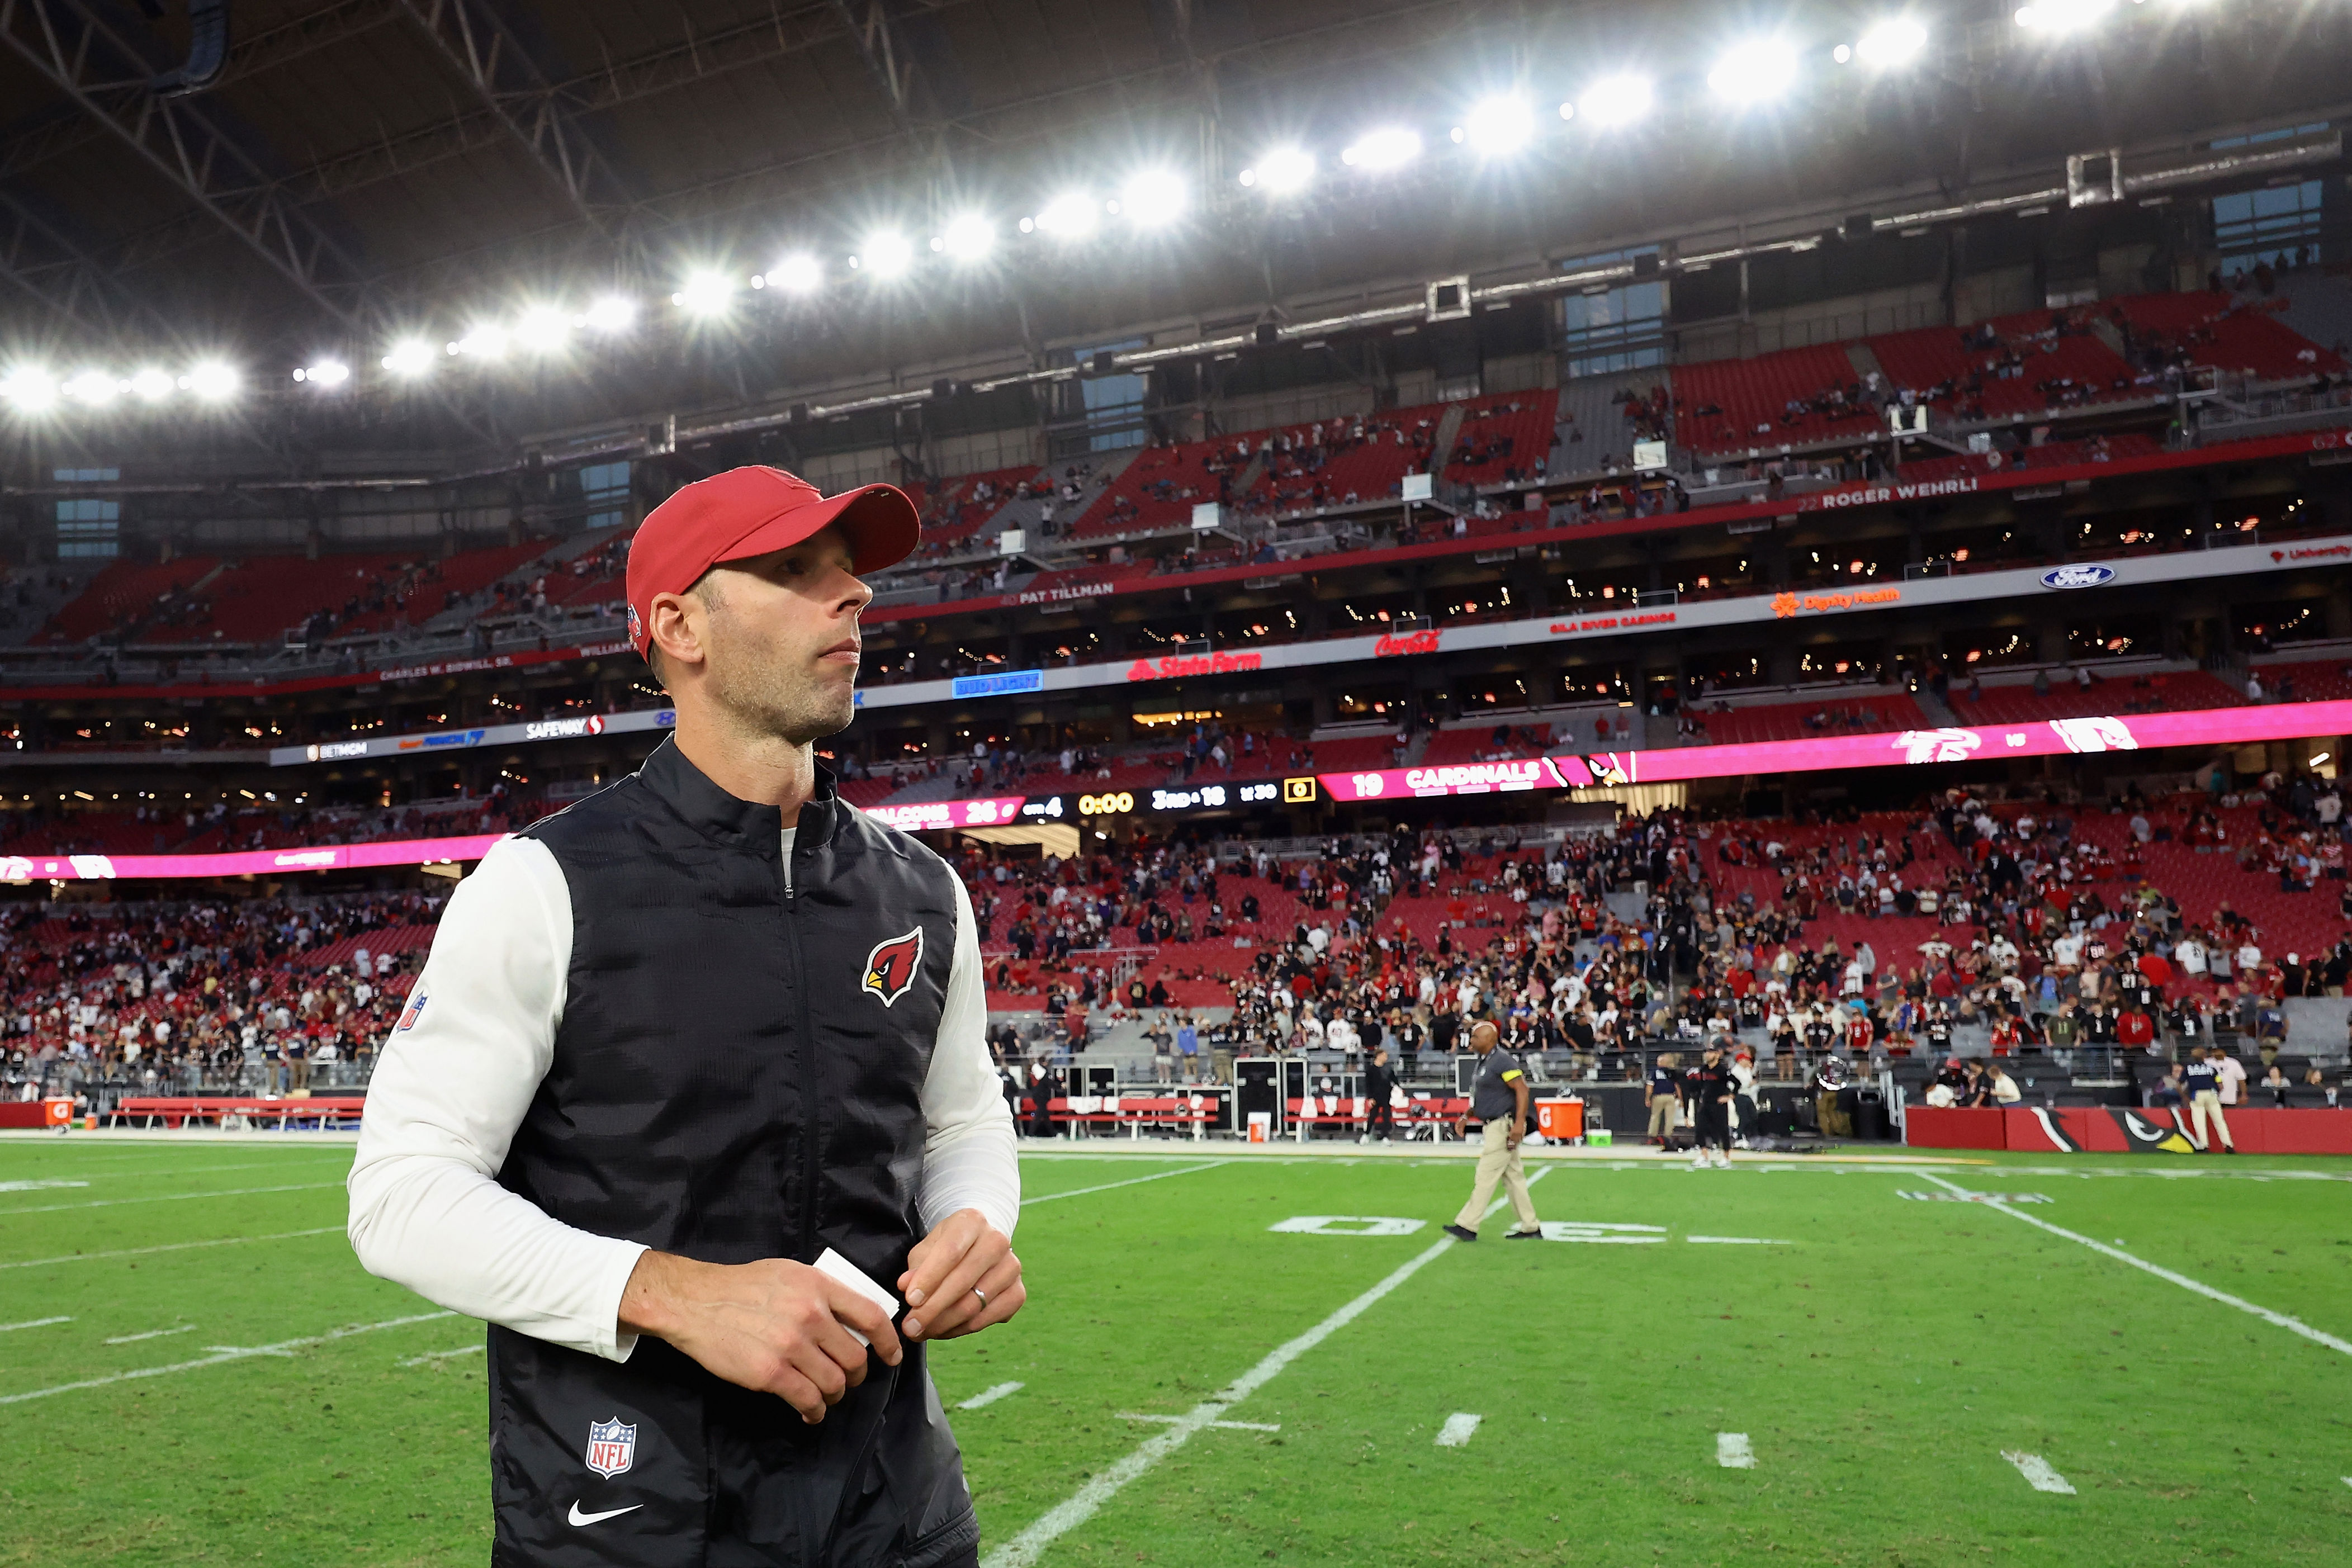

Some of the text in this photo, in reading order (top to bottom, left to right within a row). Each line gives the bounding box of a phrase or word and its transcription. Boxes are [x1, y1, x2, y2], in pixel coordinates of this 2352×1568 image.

[1822, 487, 1891, 509] ROGER
[1896, 477, 1978, 499] WEHRLI
[2053, 566, 2102, 586] Ford
[1020, 590, 1047, 604] PAT
[1050, 582, 1114, 600] TILLMAN
[1804, 586, 1900, 611] Dignity Health
[955, 673, 1039, 695] BUD LIGHT
[526, 717, 586, 740] SAFEWAY
[320, 741, 368, 759] BETMGM
[1352, 761, 1540, 798] 19 CARDINALS
[1044, 796, 1063, 817] 4
[1078, 792, 1134, 816] 0:00
[53, 1102, 68, 1119] G
[1539, 1106, 1552, 1129] G
[591, 1443, 627, 1470] NFL
